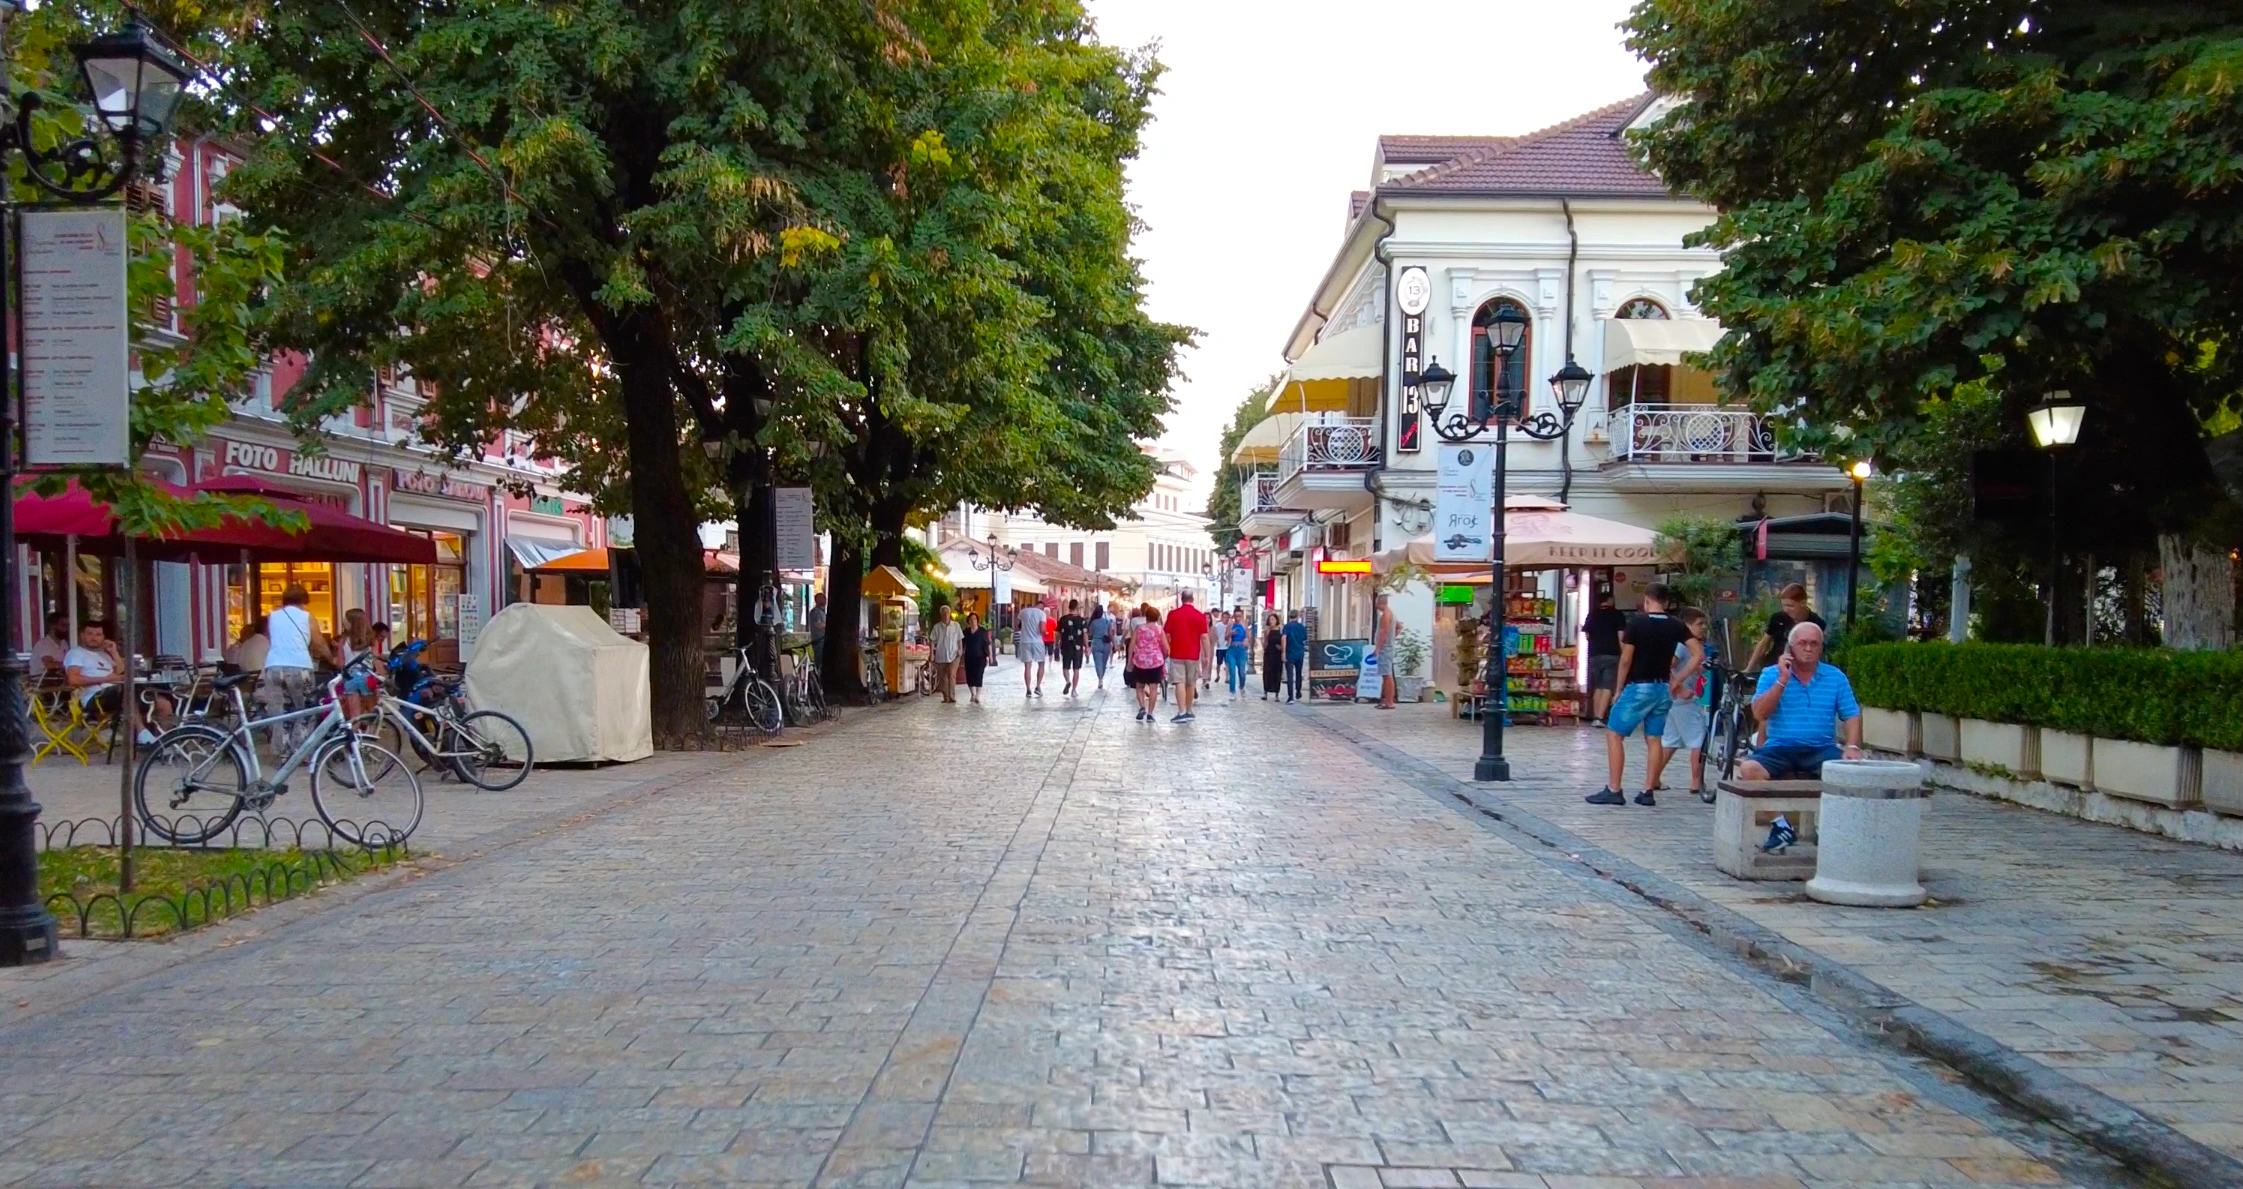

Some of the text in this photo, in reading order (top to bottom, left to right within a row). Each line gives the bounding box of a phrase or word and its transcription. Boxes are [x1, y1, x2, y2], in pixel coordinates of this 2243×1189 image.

[1408, 285, 1421, 296] 13
[1405, 318, 1420, 373] BAR
[1402, 386, 1419, 415] 13
[225, 440, 361, 483] FOTO HALLUNI
[1549, 545, 1588, 558] KEEP
[1593, 547, 1606, 558] IT
